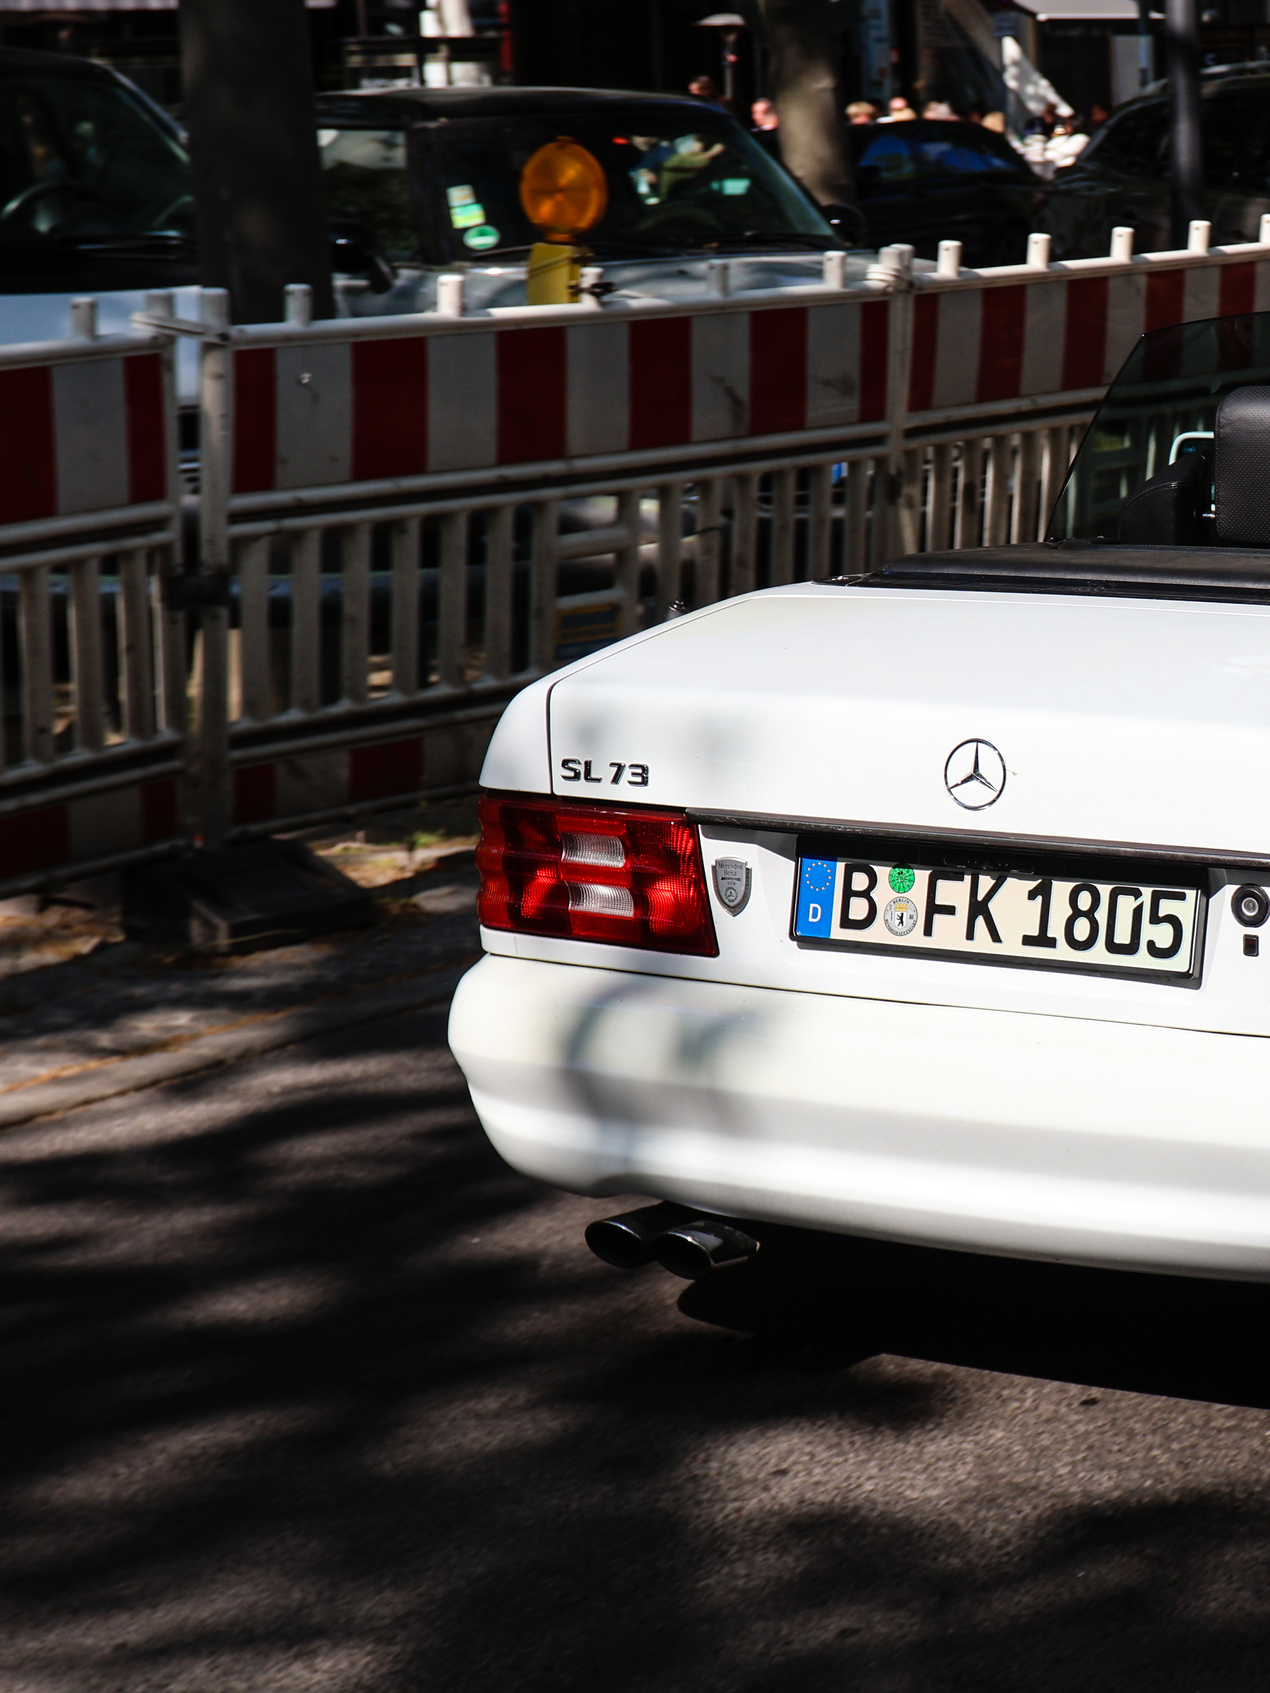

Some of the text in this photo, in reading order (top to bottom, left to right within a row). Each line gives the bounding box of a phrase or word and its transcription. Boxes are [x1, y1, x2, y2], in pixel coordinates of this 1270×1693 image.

[561, 758, 650, 787] SL 73
[808, 903, 822, 922] D
[839, 862, 1187, 959] B FK 1805
